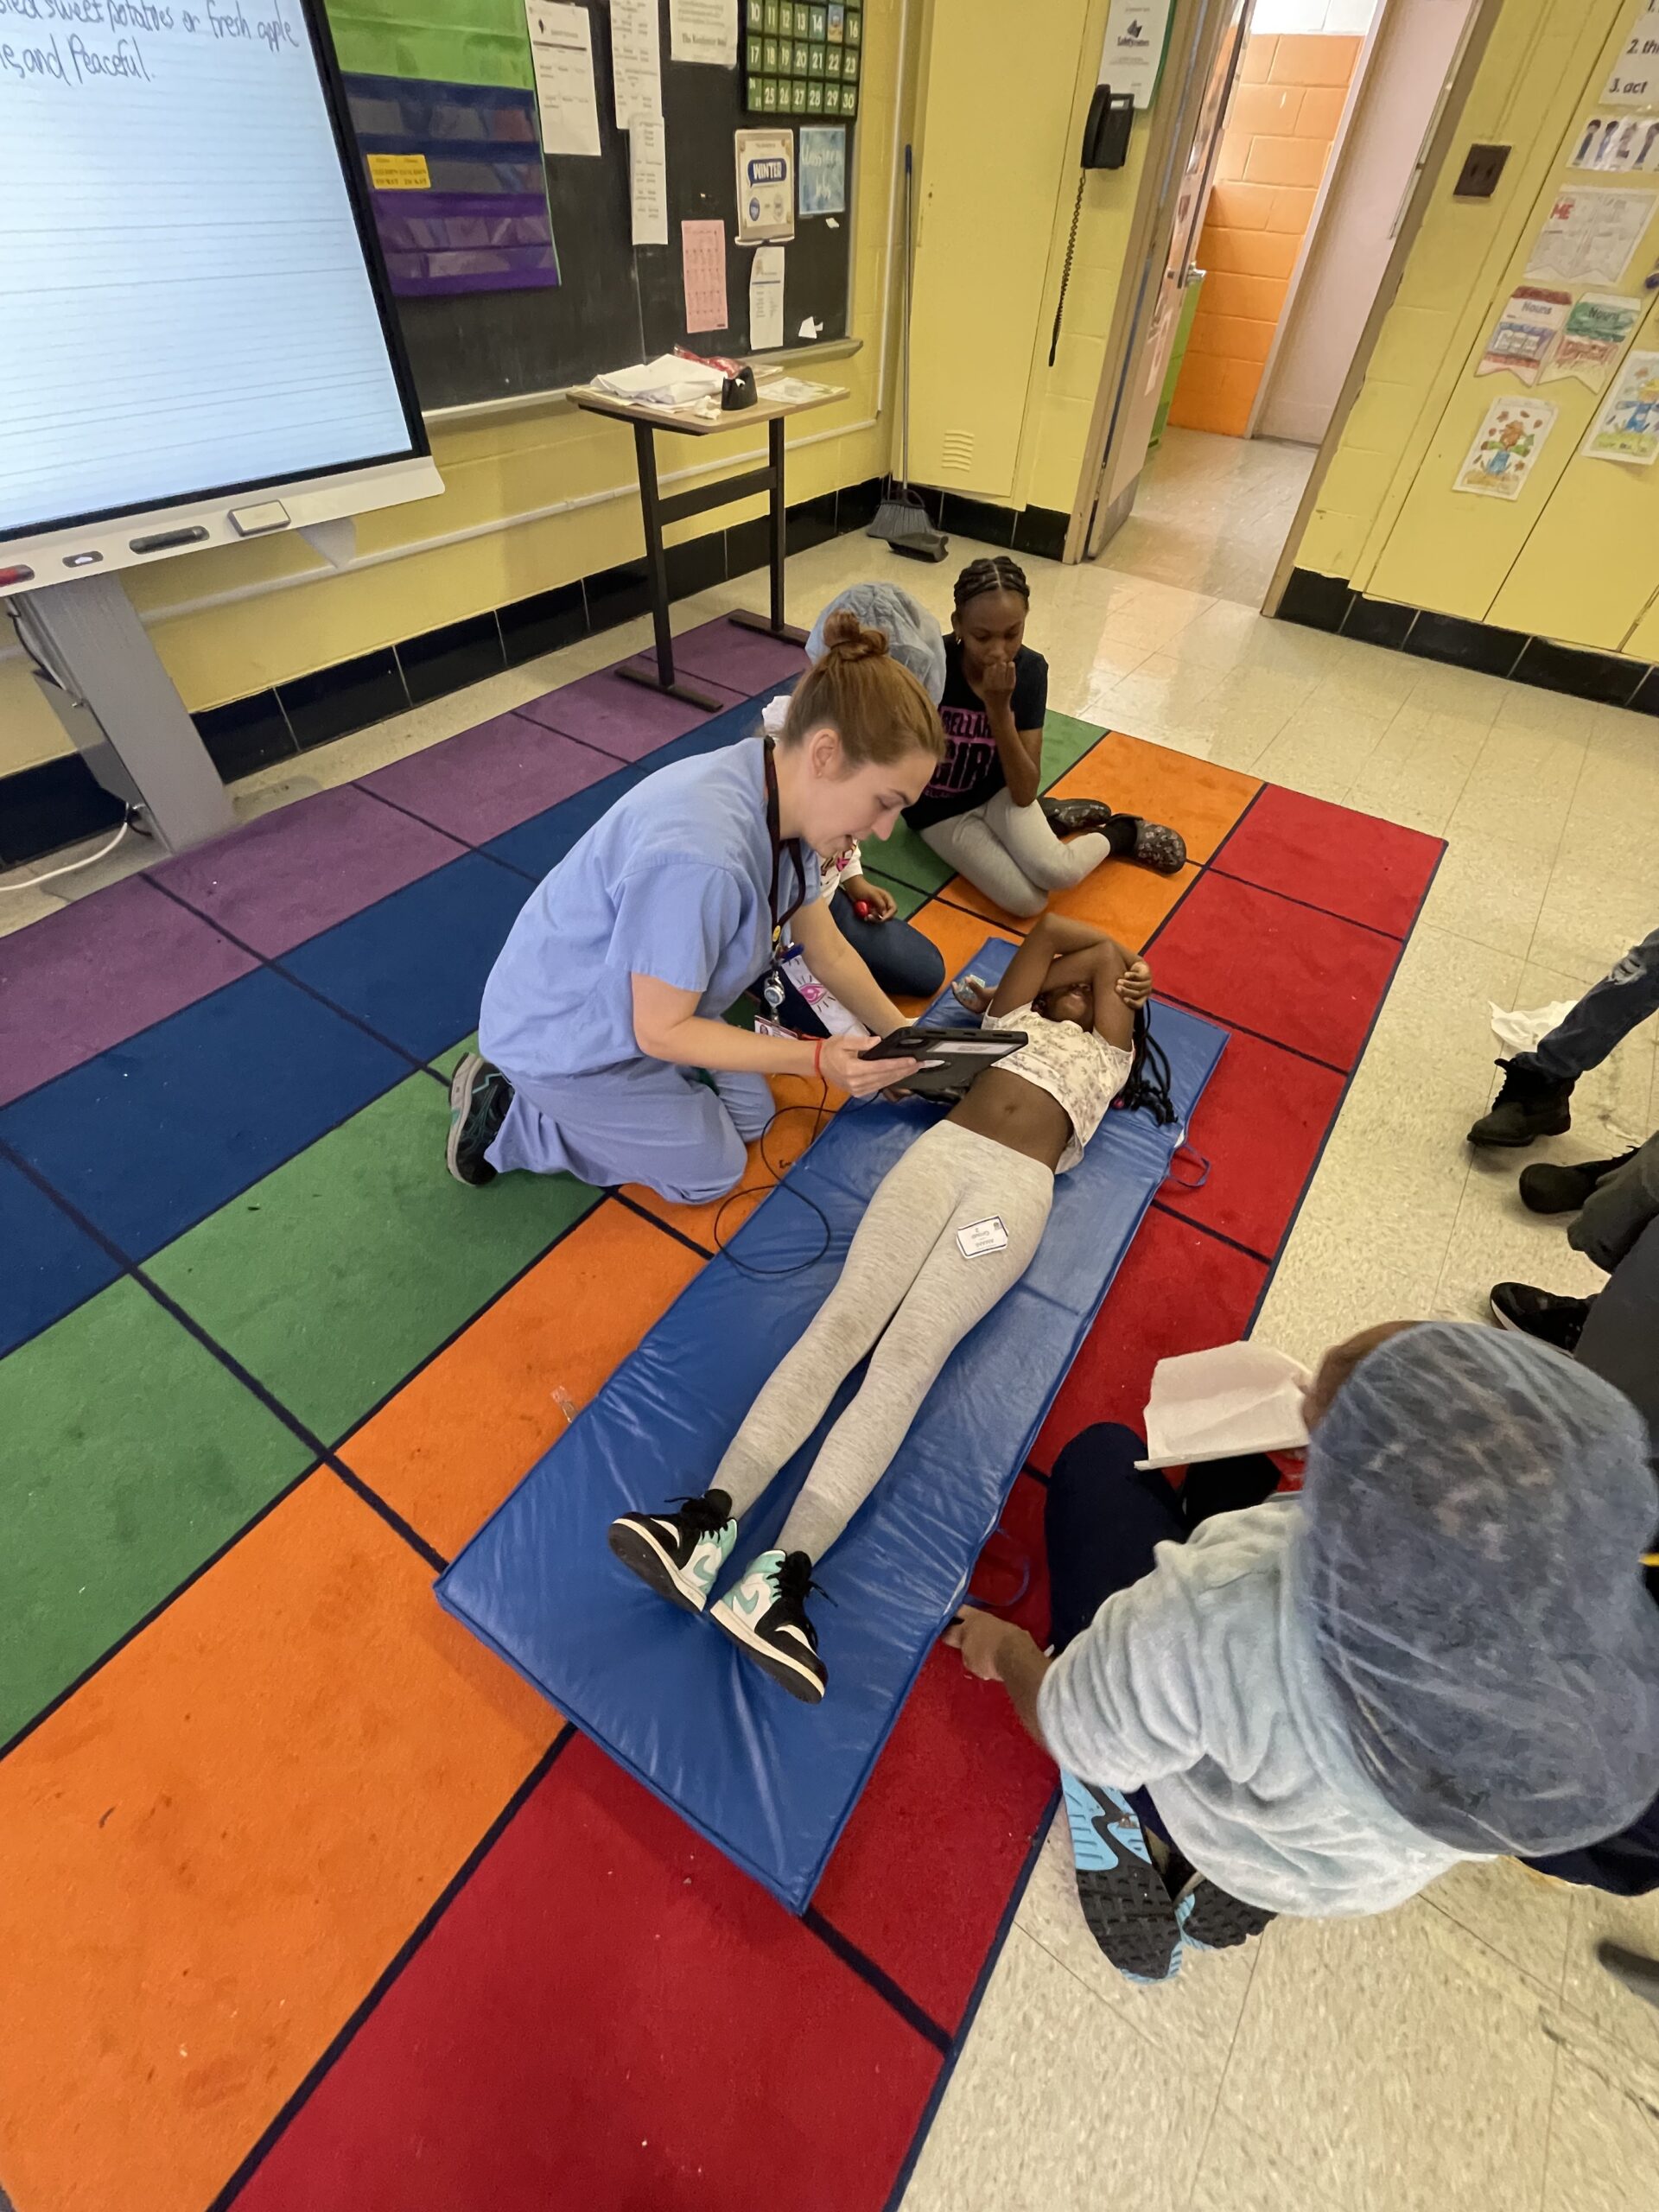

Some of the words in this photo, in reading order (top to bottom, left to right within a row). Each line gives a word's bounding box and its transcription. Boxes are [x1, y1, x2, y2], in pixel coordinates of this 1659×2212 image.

[182, 10, 200, 33] or
[207, 0, 251, 39] fresh
[257, 0, 300, 52] apple
[750, 2, 760, 22] 10
[767, 6, 776, 27] 11
[782, 9, 790, 29] 12
[797, 12, 806, 30] 13
[812, 14, 823, 33] 14
[849, 20, 858, 38] 16
[22, 33, 71, 86] and
[750, 45, 760, 63] 17
[766, 47, 775, 65] 18
[781, 47, 790, 66] 19
[796, 50, 807, 68] 20
[812, 52, 823, 69] 21
[828, 54, 839, 71] 22
[845, 57, 855, 73] 23
[765, 87, 775, 105] 25
[779, 87, 789, 105] 26
[795, 88, 804, 105] 27
[809, 90, 821, 106] 28
[827, 90, 838, 106] 29
[842, 92, 854, 109] 30
[1624, 80, 1648, 94] act
[1521, 301, 1553, 315] Nouns
